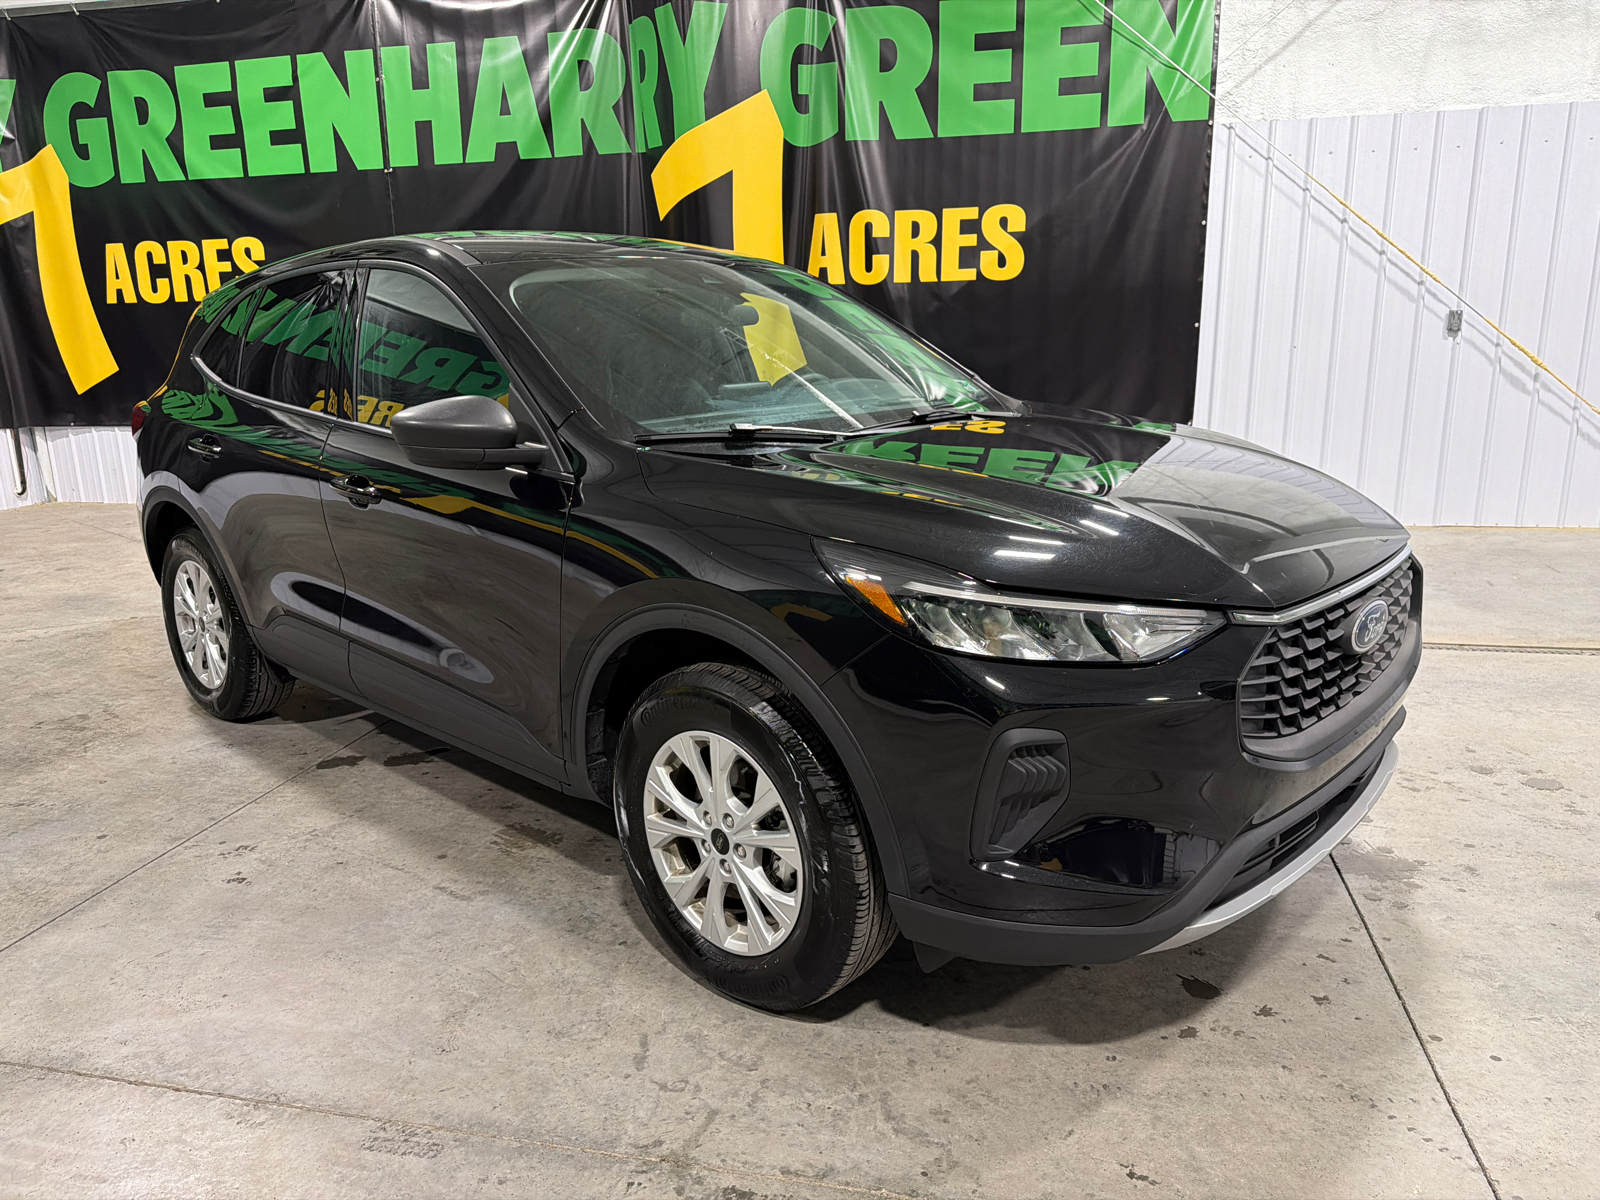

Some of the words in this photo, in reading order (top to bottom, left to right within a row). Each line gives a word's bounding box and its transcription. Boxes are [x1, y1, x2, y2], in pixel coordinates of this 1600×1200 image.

[43, 49, 385, 188] GREEN
[380, 1, 729, 168] HARRY
[760, 0, 1213, 148] GREEN
[0, 143, 119, 395] 7
[651, 89, 784, 265] 7
[808, 204, 1026, 285] ACRES
